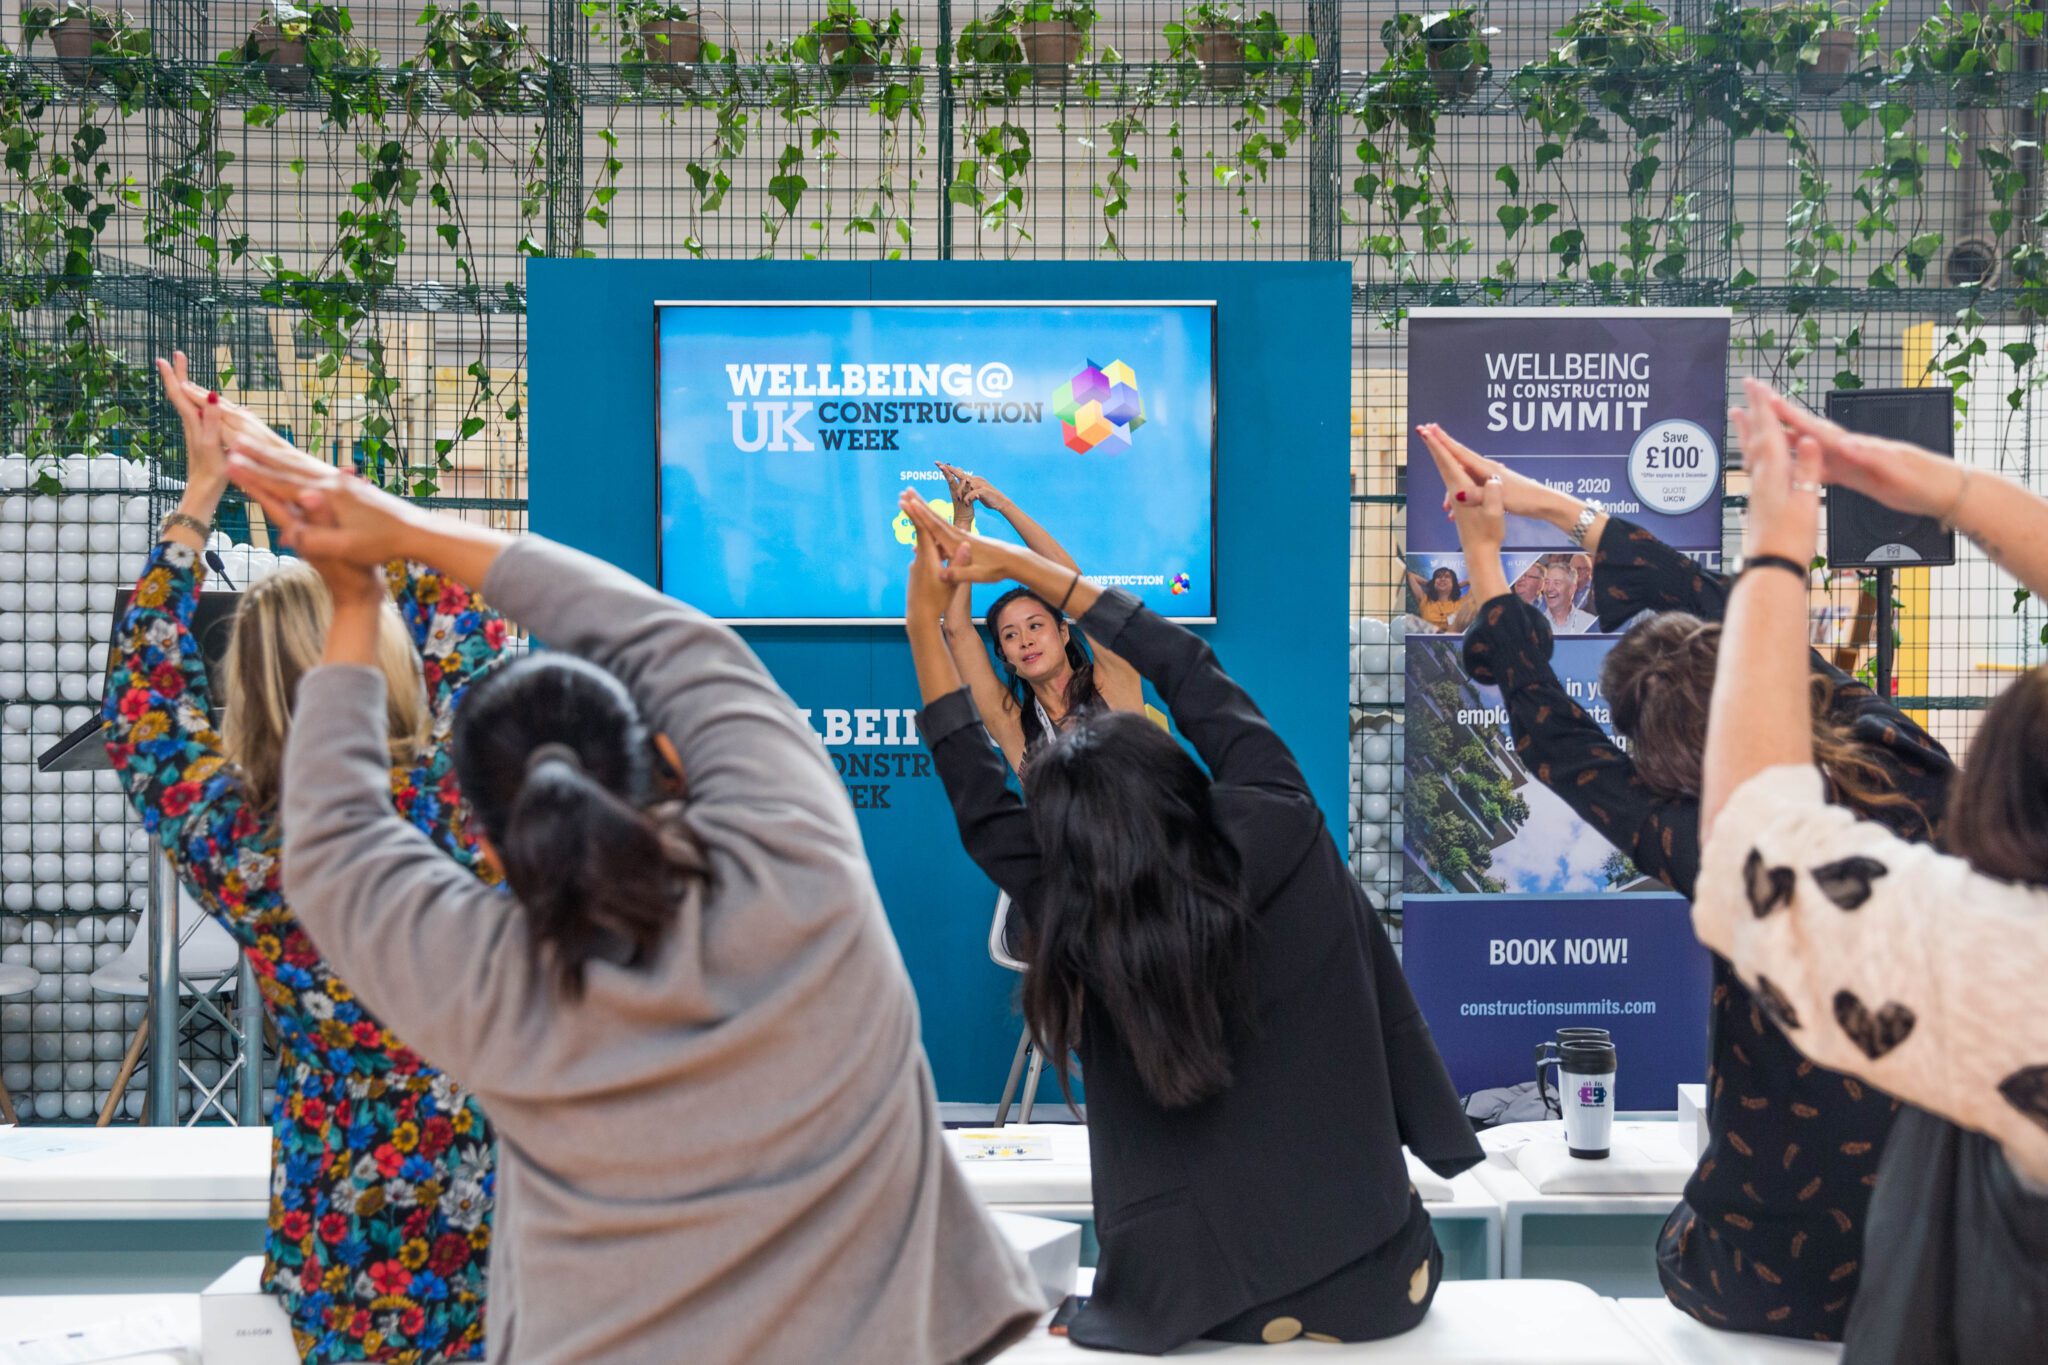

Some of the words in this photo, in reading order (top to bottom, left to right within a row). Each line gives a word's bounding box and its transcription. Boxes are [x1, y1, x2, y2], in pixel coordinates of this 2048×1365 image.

[1484, 353, 1650, 380] WELLBEING
[726, 362, 1014, 398] WELLBEING@
[1487, 384, 1506, 398] IN
[1513, 383, 1650, 399] CONSTRUCTION
[1487, 401, 1648, 432] SUMMIT
[727, 401, 815, 453] UK
[818, 401, 1043, 424] CONSTRUCTION
[818, 429, 899, 451] WEEK
[1662, 431, 1689, 443] Save
[900, 471, 949, 481] SPONSOR
[1577, 478, 1611, 493] 2020
[1662, 487, 1687, 495] QUOTE
[1603, 500, 1640, 514] ondon
[1085, 575, 1165, 585] ONSTRUCTION
[1566, 677, 1582, 697] in
[1457, 705, 1510, 729] emplo
[1489, 939, 1557, 965] BOOK
[1563, 938, 1629, 964] NOW!
[1460, 999, 1656, 1016] constructionsummits.com
